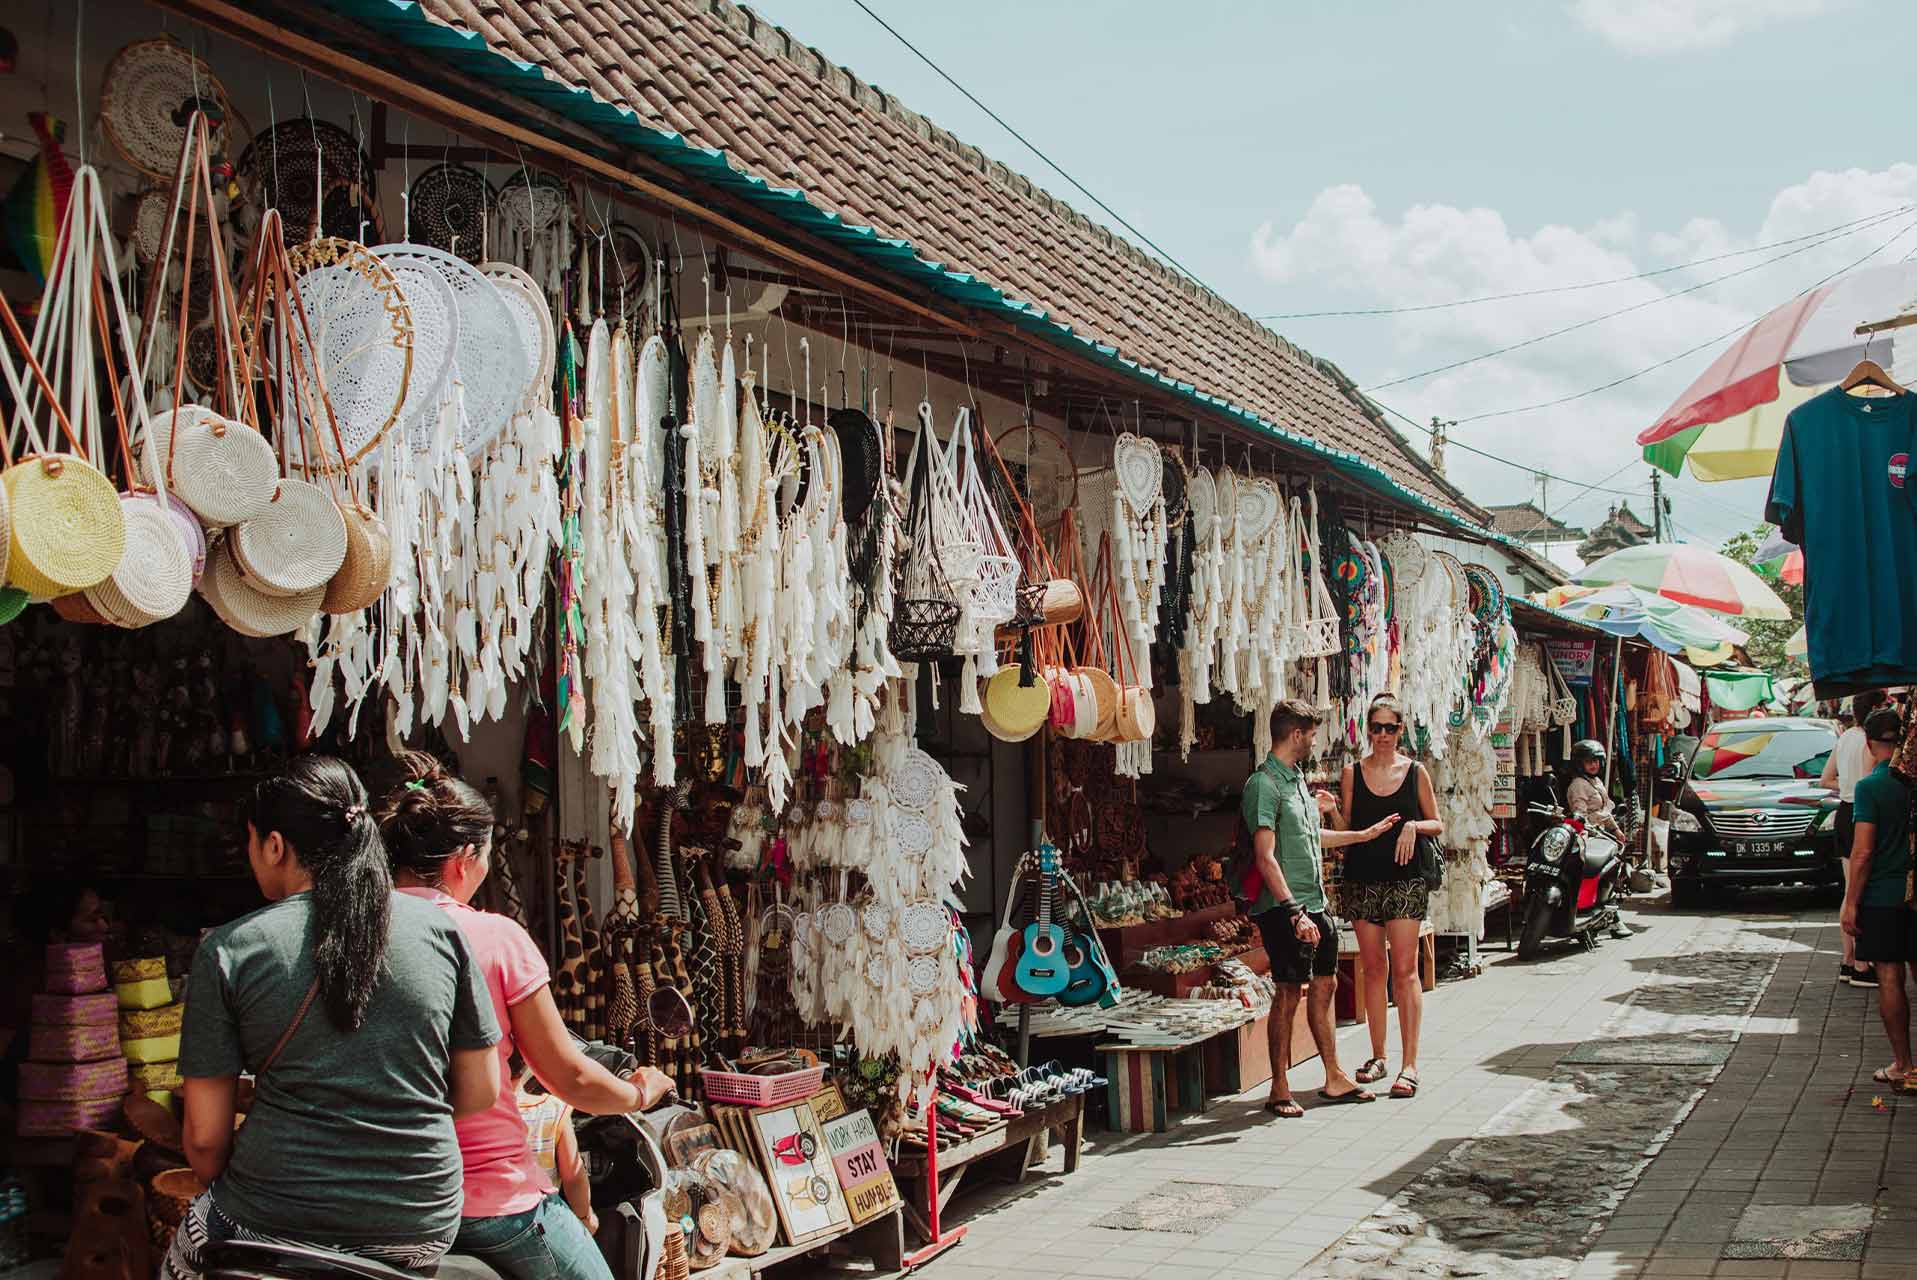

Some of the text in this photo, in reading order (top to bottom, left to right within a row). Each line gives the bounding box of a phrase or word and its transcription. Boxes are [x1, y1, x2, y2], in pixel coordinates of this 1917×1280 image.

[1551, 650, 1590, 662] UNDRY
[826, 1116, 874, 1151] WORK HARD
[847, 1149, 878, 1178] STAY
[854, 1179, 895, 1215] HUMBLE
